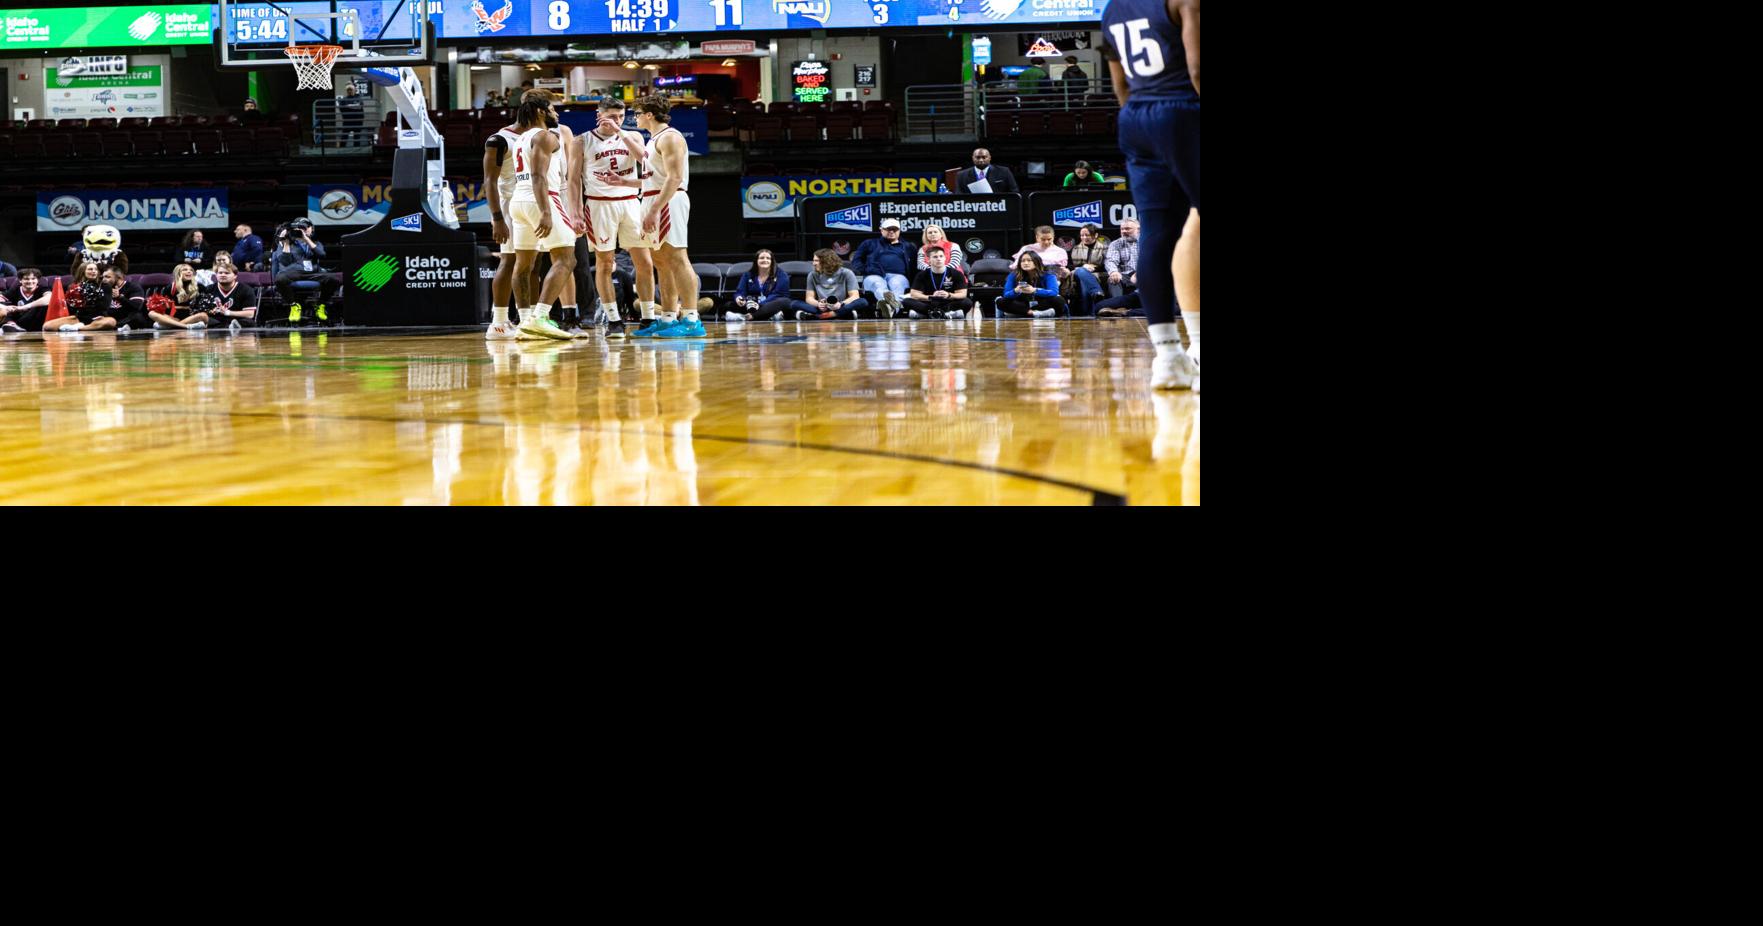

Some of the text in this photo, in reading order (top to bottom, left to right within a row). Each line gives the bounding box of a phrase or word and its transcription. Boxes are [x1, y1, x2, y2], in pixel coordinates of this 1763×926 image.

[231, 7, 292, 18] TIME OF DAY
[605, 0, 668, 18] 14:39
[708, 0, 743, 25] 11
[777, 1, 824, 14] NAU
[873, 3, 889, 24] 3
[948, 6, 960, 21] 4
[6, 16, 38, 27] Idaho
[165, 12, 197, 23] Idaho
[548, 0, 570, 31] 8
[6, 24, 49, 36] Central
[165, 21, 209, 32] Central
[237, 19, 287, 40] 5:44
[612, 19, 660, 32] HALF 1
[1109, 18, 1166, 79] 15
[797, 75, 825, 83] BAKED
[795, 87, 829, 96] SERVED
[800, 95, 824, 103] HERE
[595, 149, 630, 161] EASTERN
[610, 157, 618, 170] 2
[788, 178, 937, 196] NORTHERN
[89, 197, 225, 220] MONTANA
[879, 199, 1007, 216] #ExperienceElevated
[405, 256, 450, 268] Idaho
[405, 266, 464, 281] Central
